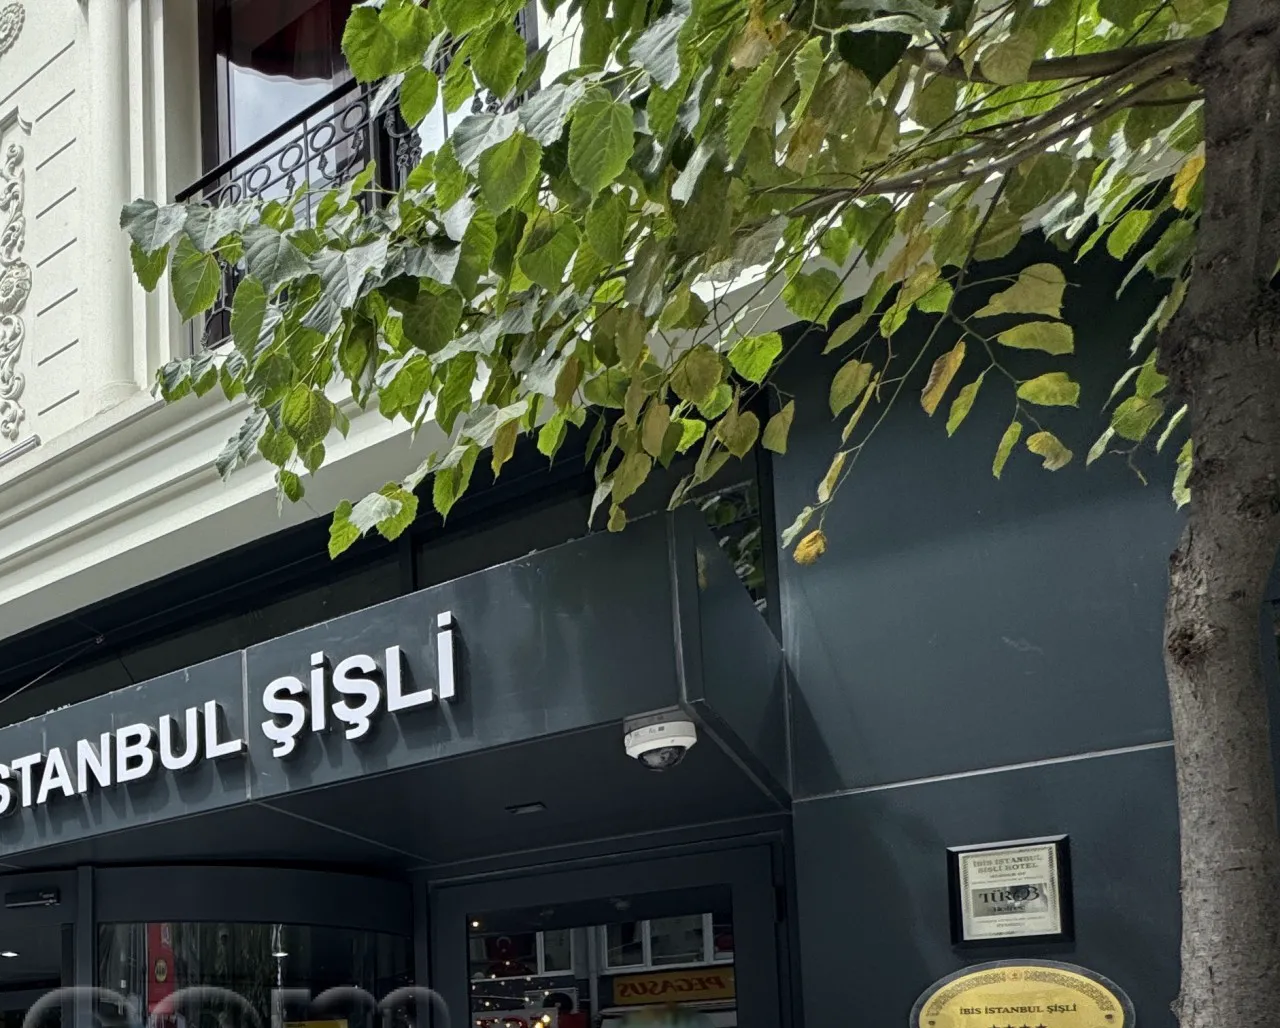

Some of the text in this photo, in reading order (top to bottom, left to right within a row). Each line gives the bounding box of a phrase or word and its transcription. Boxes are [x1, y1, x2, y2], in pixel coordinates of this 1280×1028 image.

[261, 610, 457, 758] ŞİŞLİ
[959, 1004, 1077, 1015] İBİS İSTANBUL ŞİŞLİ
